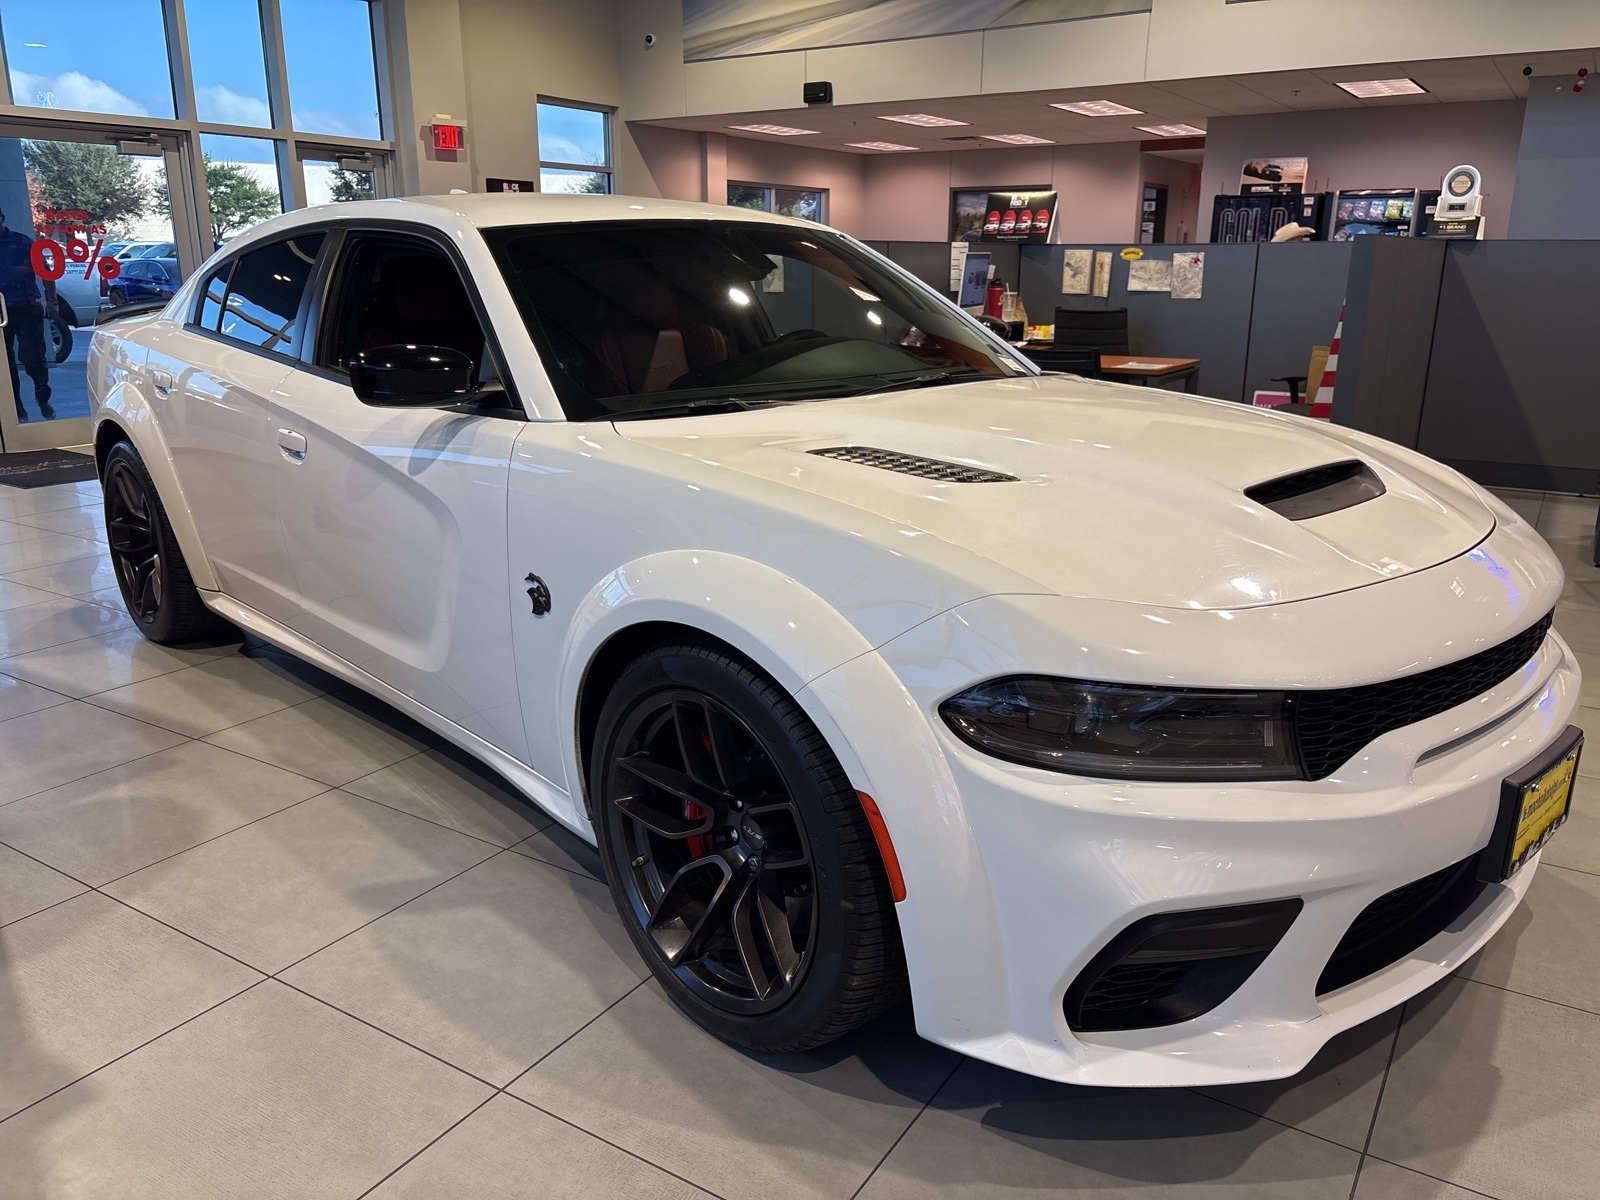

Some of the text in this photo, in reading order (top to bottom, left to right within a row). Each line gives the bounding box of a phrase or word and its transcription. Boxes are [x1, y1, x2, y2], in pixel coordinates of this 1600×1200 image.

[438, 126, 459, 148] EXIT
[45, 210, 89, 220] RATES
[36, 223, 107, 235] AS LOW AS
[30, 238, 121, 281] 0%
